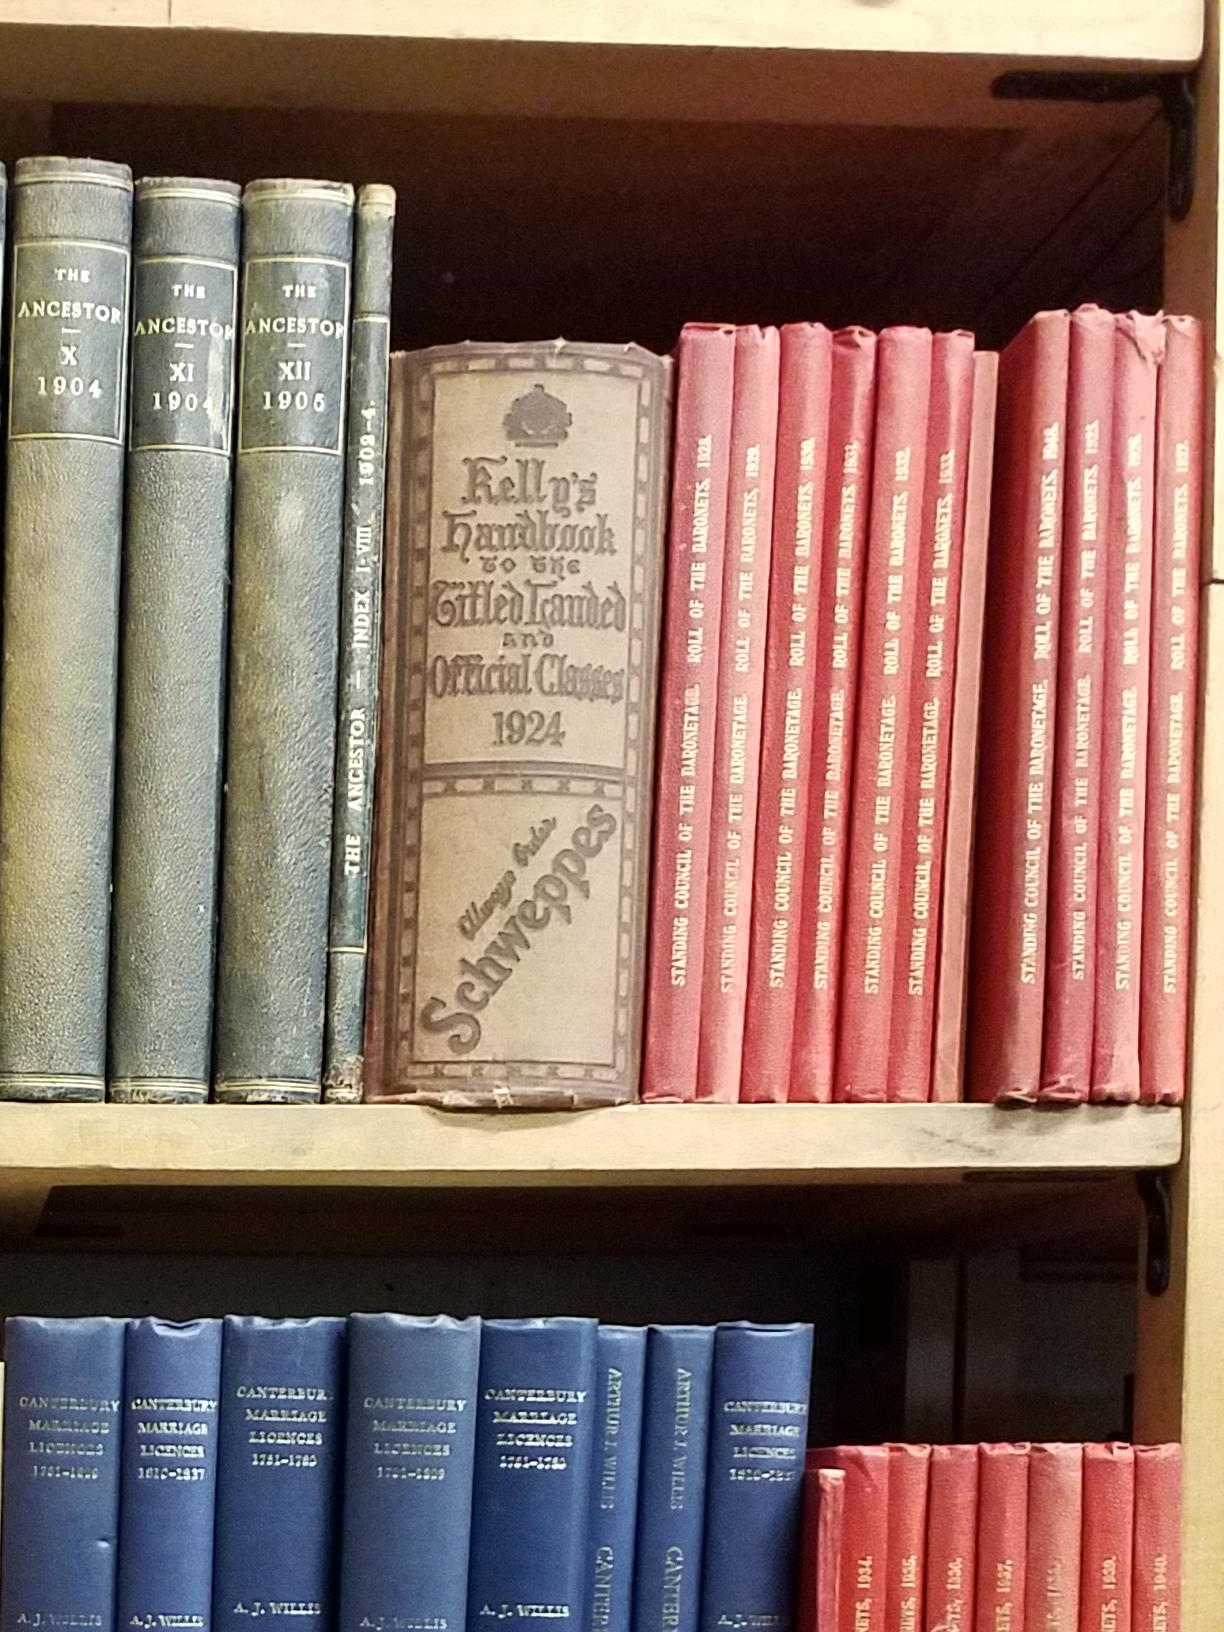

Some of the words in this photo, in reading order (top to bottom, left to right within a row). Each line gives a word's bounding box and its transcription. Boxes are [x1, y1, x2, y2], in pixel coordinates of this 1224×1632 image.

[55, 269, 90, 283] THE
[282, 285, 317, 298] THE
[18, 300, 121, 325] ANCESTOR
[245, 318, 344, 340] ANCESTOR
[61, 346, 78, 366] X
[278, 361, 311, 382] XII
[37, 376, 102, 400] 1904
[461, 455, 598, 517] Kelly's
[442, 509, 617, 564] Handbook
[431, 579, 524, 628] Titled
[524, 579, 627, 632] Landed
[888, 574, 903, 604] THE
[351, 591, 371, 649] INDEX
[886, 610, 900, 631] OF
[883, 636, 900, 676] ROLL
[431, 653, 533, 699] Official
[533, 653, 625, 704] Classes
[491, 709, 565, 748] 1924
[347, 707, 366, 812] ANCESTOR
[874, 795, 891, 825] THE
[344, 833, 361, 875] THE
[874, 832, 889, 853] OF
[870, 858, 887, 918] COUNCIL
[421, 804, 617, 1054] Schweppes
[865, 926, 883, 994] STANDING
